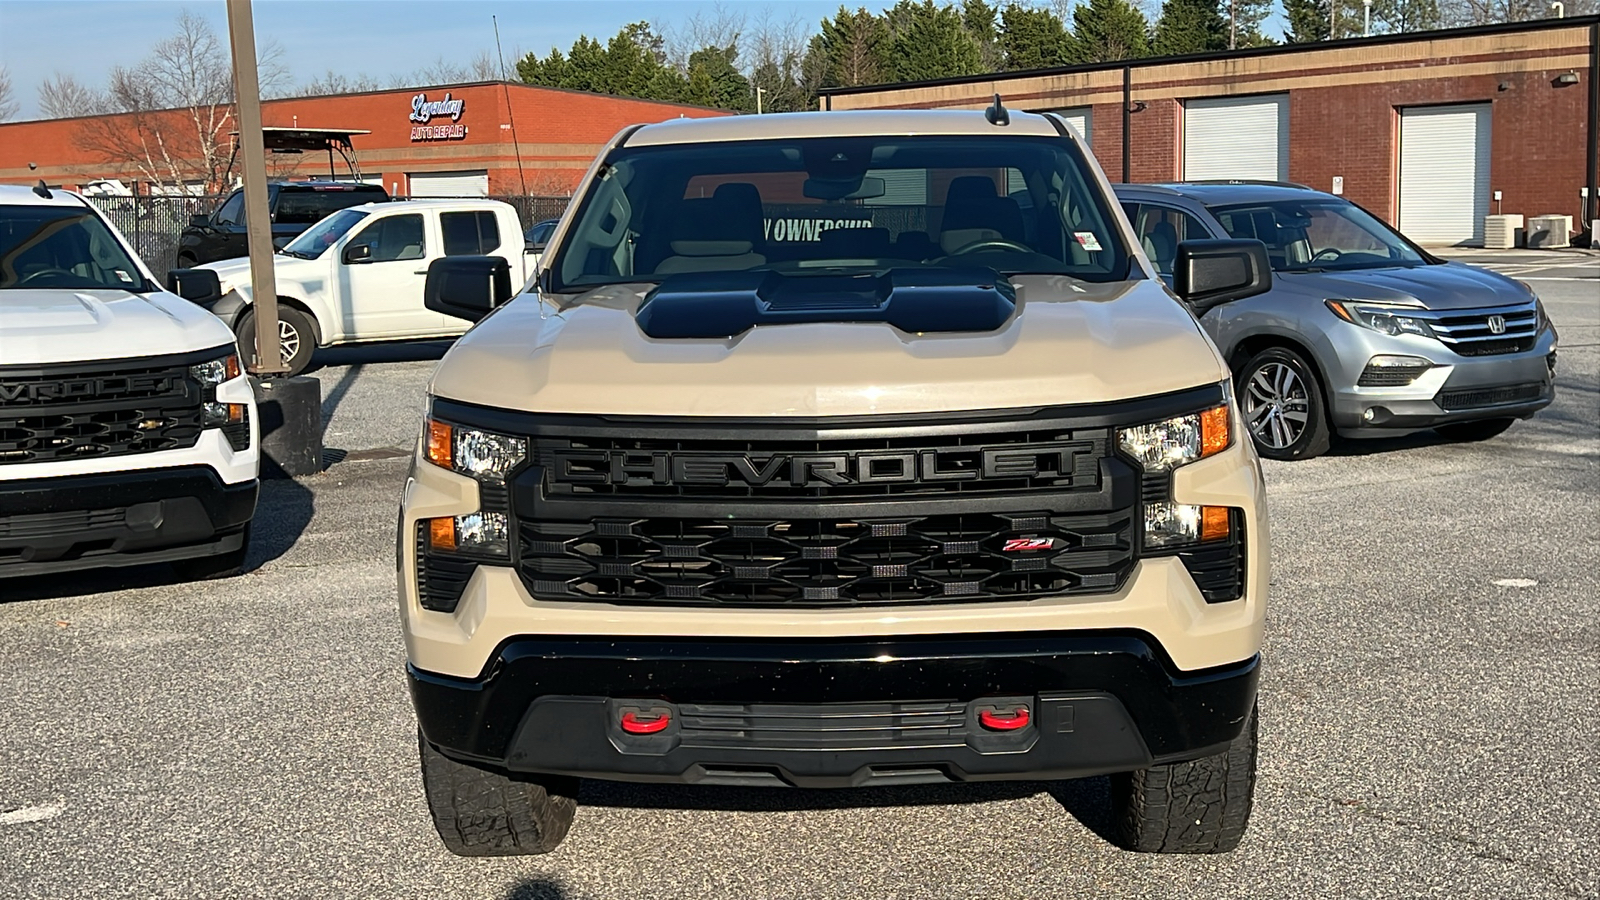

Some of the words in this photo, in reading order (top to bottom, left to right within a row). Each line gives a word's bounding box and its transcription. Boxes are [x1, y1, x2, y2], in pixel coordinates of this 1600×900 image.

[409, 93, 463, 122] Legendary
[411, 127, 433, 140] AUTO
[433, 125, 464, 138] REPAIR
[554, 442, 1093, 486] CHEVROLET
[1002, 538, 1054, 551] Z71
